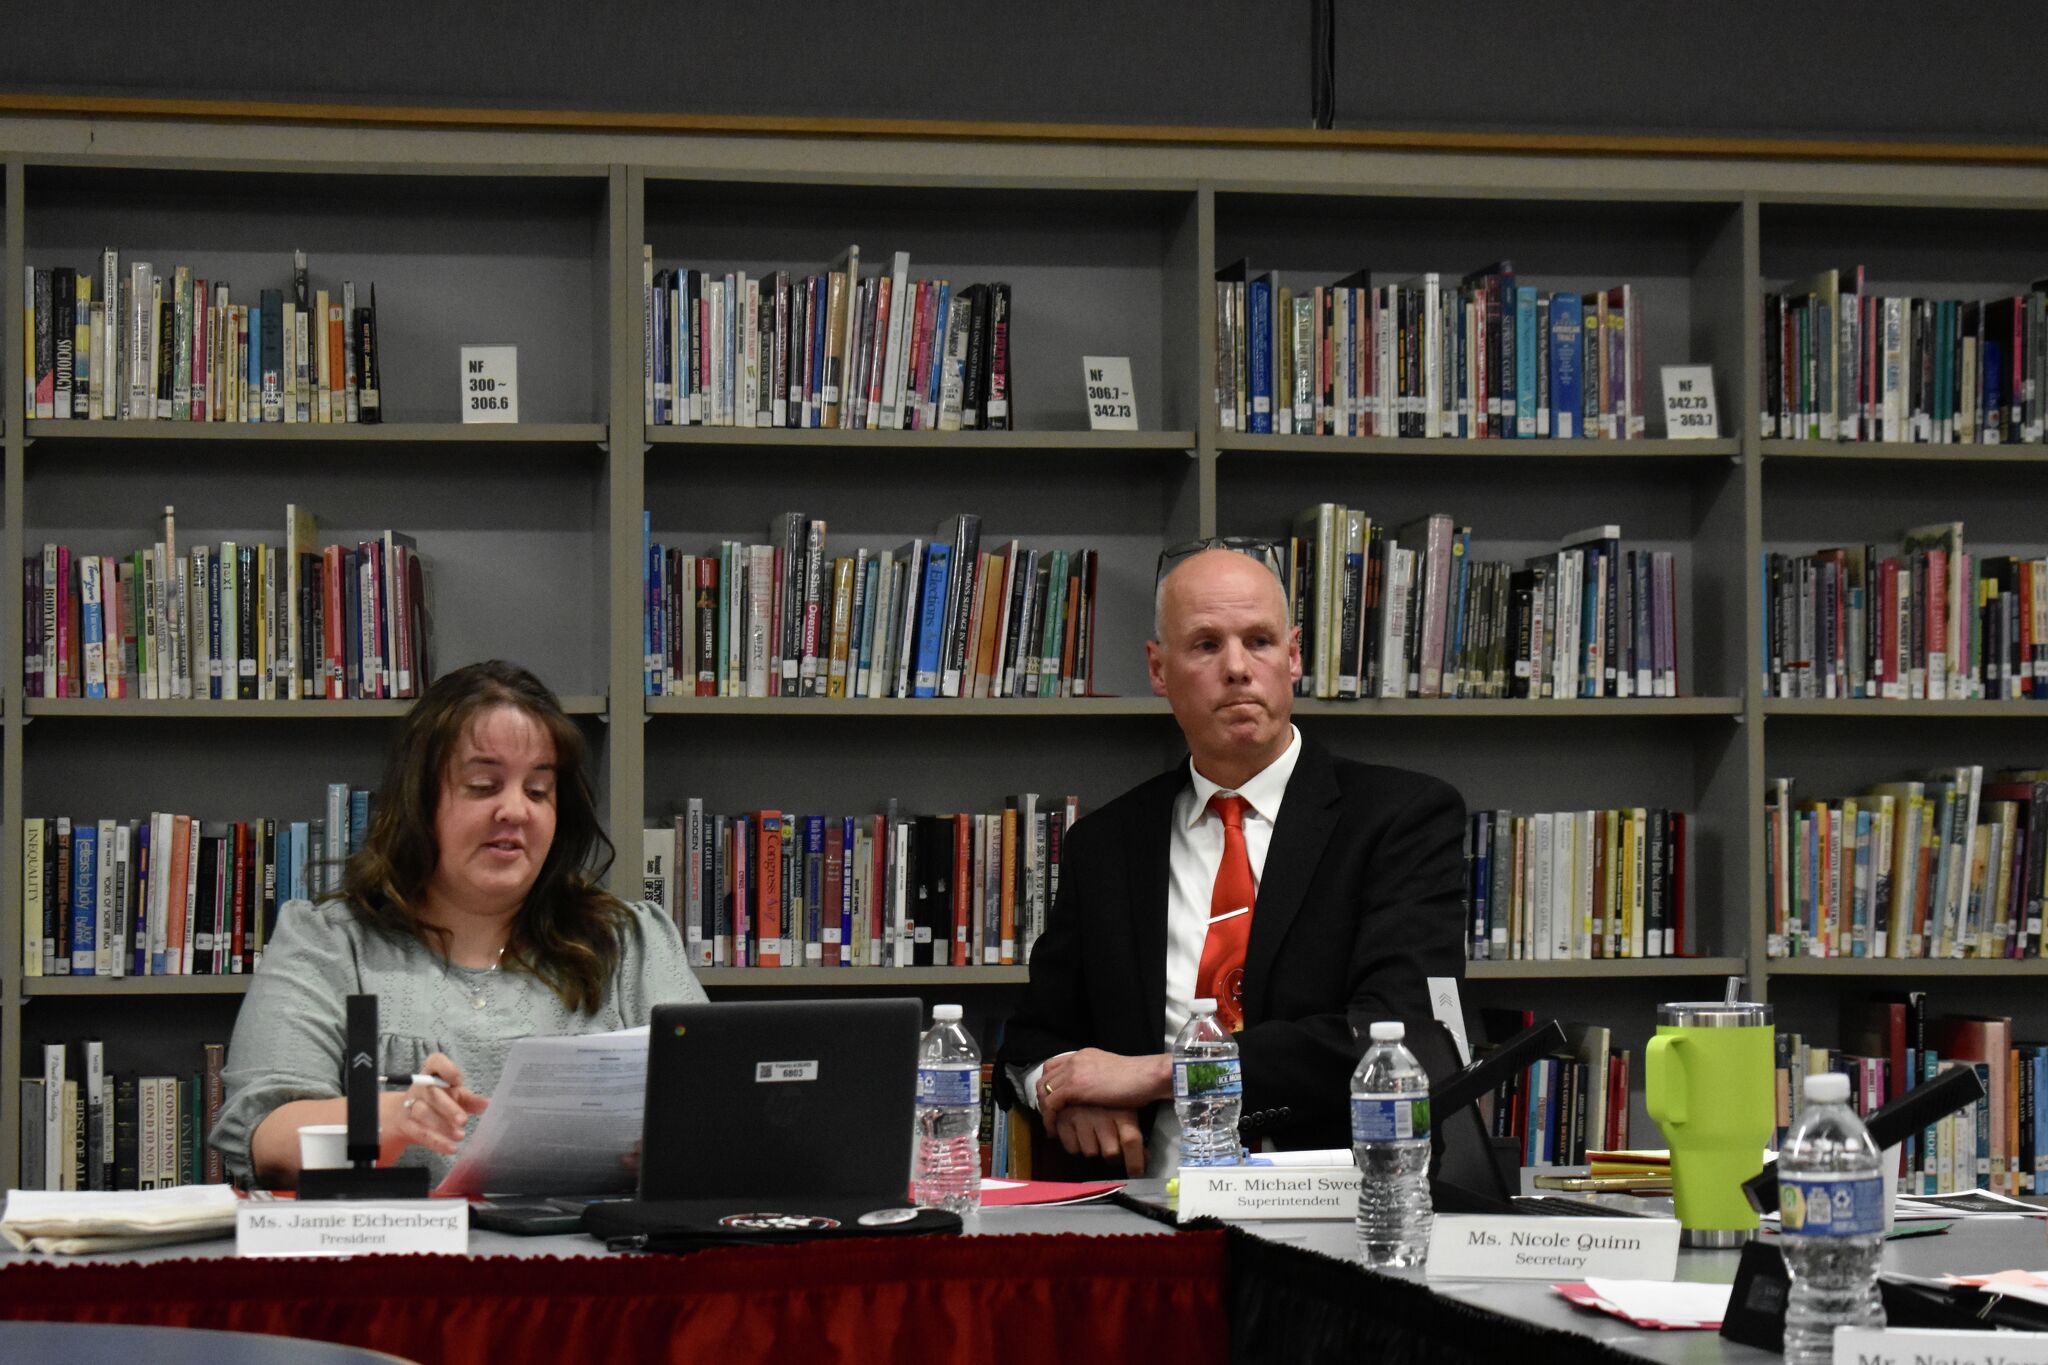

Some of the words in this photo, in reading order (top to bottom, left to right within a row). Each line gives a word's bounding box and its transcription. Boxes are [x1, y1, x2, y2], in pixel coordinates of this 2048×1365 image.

[762, 335, 769, 346] WE
[1502, 315, 1511, 357] SUPREME
[57, 339, 72, 392] SOCIOLOGY
[469, 360, 484, 373] NF
[971, 348, 979, 364] AND
[470, 378, 495, 392] 300
[1091, 369, 1104, 381] NF
[1502, 359, 1512, 392] COURT
[1678, 380, 1692, 391] NF
[968, 381, 976, 401] MANY
[992, 374, 1005, 401] KLA
[1090, 387, 1120, 400] 306.7
[471, 397, 509, 410] 306.6
[1095, 404, 1131, 418] 342.73
[1668, 398, 1708, 409] 342.73
[1680, 414, 1713, 426] 363.7
[812, 552, 821, 570] We
[809, 574, 820, 601] Shall
[965, 562, 973, 596] WOMEN'S
[1347, 568, 1357, 599] Medal
[156, 581, 164, 616] PREJUDICE
[926, 569, 943, 627] Elections
[1348, 603, 1356, 613] of
[1826, 583, 1835, 617] DEATH
[44, 588, 55, 642] BODYTALK
[960, 596, 969, 630] SUFFRAGE
[1535, 603, 1543, 616] THE
[157, 622, 166, 653] AMERICA
[959, 632, 967, 641] IN
[1346, 617, 1357, 650] Honor
[1532, 620, 1542, 658] WARRIOR'S
[1826, 620, 1836, 664] PENALTY
[1531, 660, 1540, 683] HEART
[993, 819, 1000, 832] WE
[1831, 817, 1839, 832] THE
[764, 834, 778, 894] Congress
[1831, 835, 1839, 872] ADAPTIVE
[28, 828, 38, 903] INEQUALITY
[58, 848, 68, 904] INTENTIONS
[1652, 862, 1662, 874] But
[103, 876, 112, 897] VOICES
[266, 864, 274, 890] SPEAKING
[645, 881, 653, 890] OF
[1652, 876, 1661, 889] Not
[104, 899, 111, 908] OF
[783, 1069, 803, 1078] 6803
[1220, 1076, 1229, 1084] ICE
[49, 1089, 58, 1122] Possibility
[146, 1085, 155, 1128] SECOND
[165, 1083, 174, 1125] SECOND
[76, 1099, 84, 1136] FIRST
[182, 1114, 191, 1137] ON
[146, 1131, 155, 1144] TO
[165, 1127, 174, 1140] TO
[76, 1138, 85, 1158] OF
[165, 1143, 174, 1172] NONE
[182, 1140, 192, 1167] HER
[146, 1146, 155, 1175] NONE
[76, 1161, 85, 1183] ALL
[1209, 1179, 1237, 1192] Mr.
[1244, 1178, 1312, 1192] Michael
[1318, 1178, 1362, 1192] Swee
[1238, 1196, 1340, 1209] Superintendent
[249, 1215, 281, 1230] Ms.
[288, 1214, 346, 1230] Jamie
[353, 1214, 458, 1232] Eichenberg
[321, 1233, 386, 1246] President
[1468, 1231, 1501, 1246] Ms.
[1510, 1232, 1570, 1248] Nicole
[1577, 1234, 1641, 1252] Quinn
[1516, 1252, 1587, 1269] Secretary
